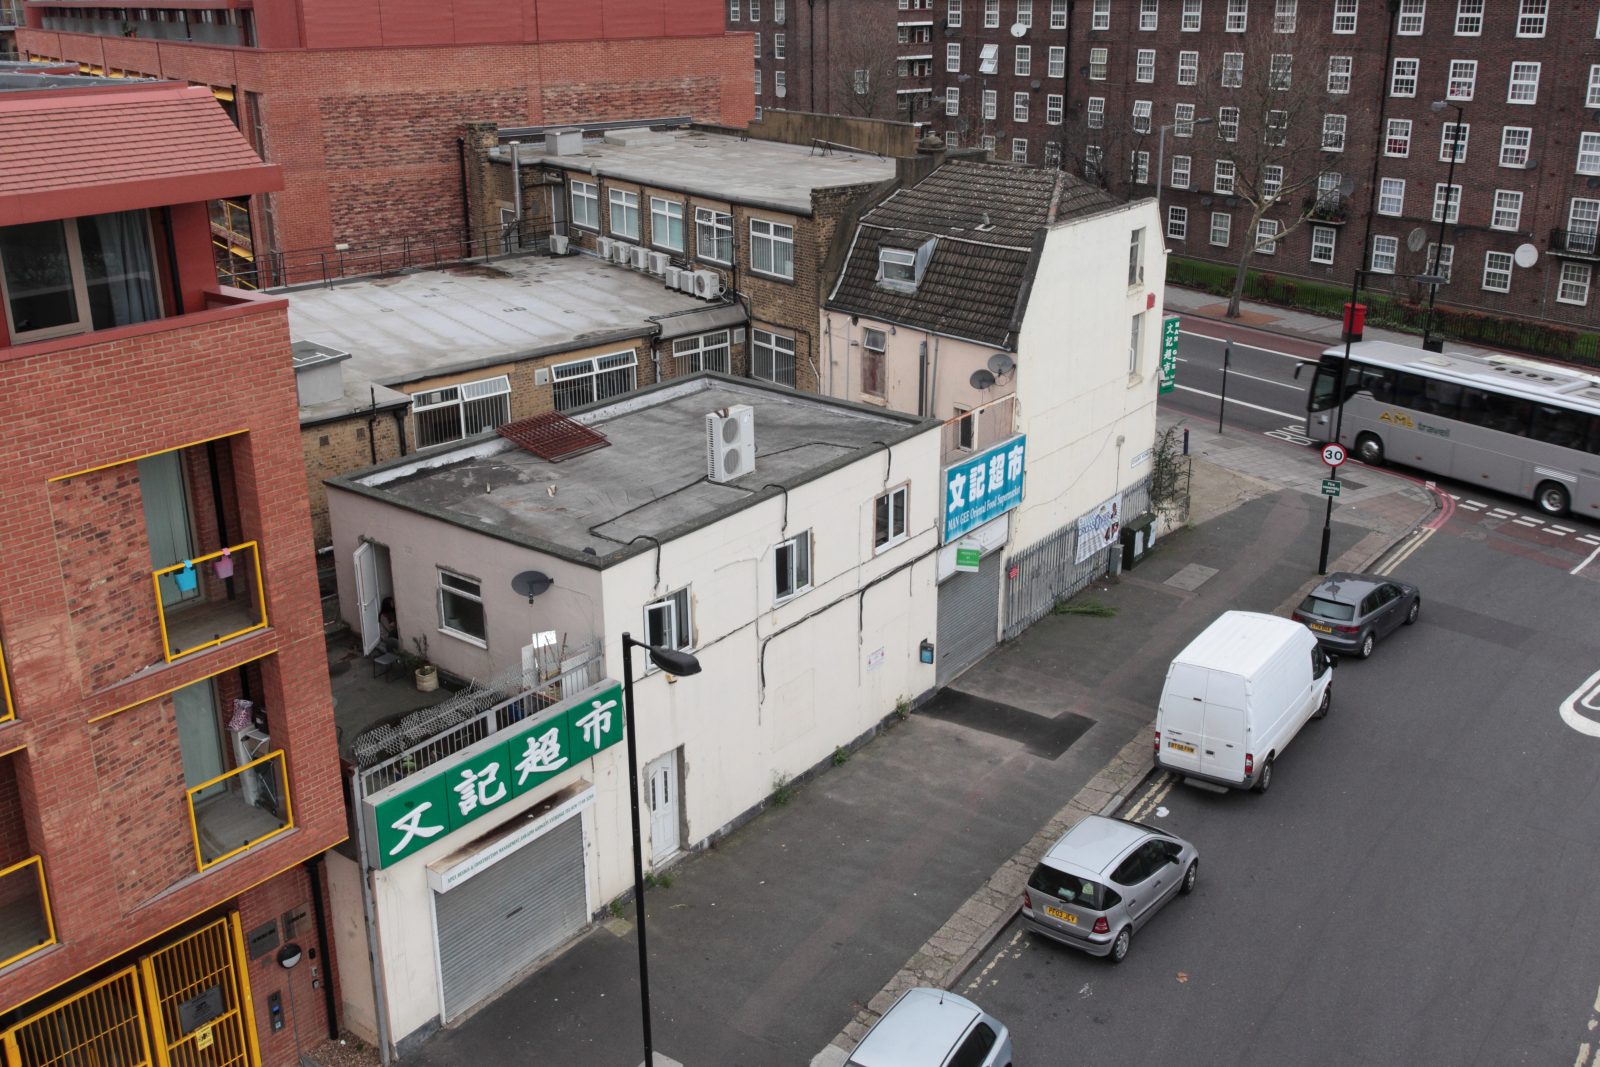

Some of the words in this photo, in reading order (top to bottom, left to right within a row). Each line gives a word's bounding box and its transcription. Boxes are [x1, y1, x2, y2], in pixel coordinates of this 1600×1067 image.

[1162, 323, 1173, 373] 文記超市
[1418, 422, 1450, 437] travel
[949, 445, 1024, 513] 文記超市
[1325, 450, 1343, 461] 30
[948, 517, 960, 530] MAN
[960, 510, 970, 525] GEE
[970, 501, 987, 519] Oriental
[987, 496, 998, 511] Food
[997, 486, 1021, 506] Supermarket
[389, 700, 617, 856] 文記超市
